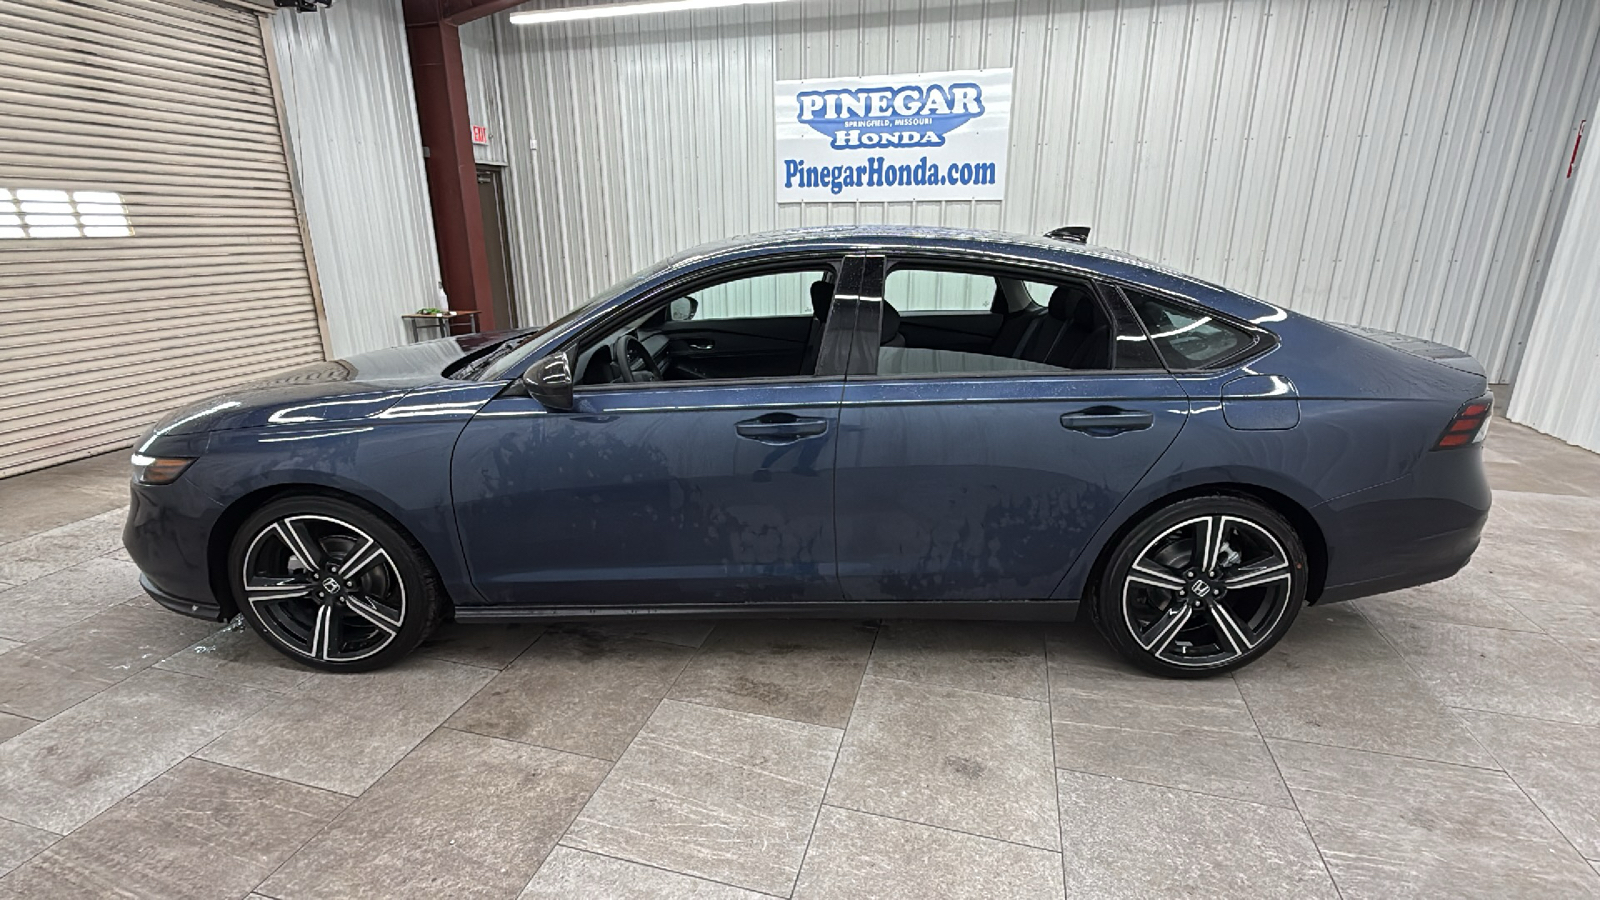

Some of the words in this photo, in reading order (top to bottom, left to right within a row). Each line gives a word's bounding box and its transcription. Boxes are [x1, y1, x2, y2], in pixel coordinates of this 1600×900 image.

[799, 86, 982, 121] PINEGAR
[894, 117, 933, 127] MISSOURI
[834, 130, 942, 146] HONDA
[784, 156, 996, 195] PinegarHonda.com
